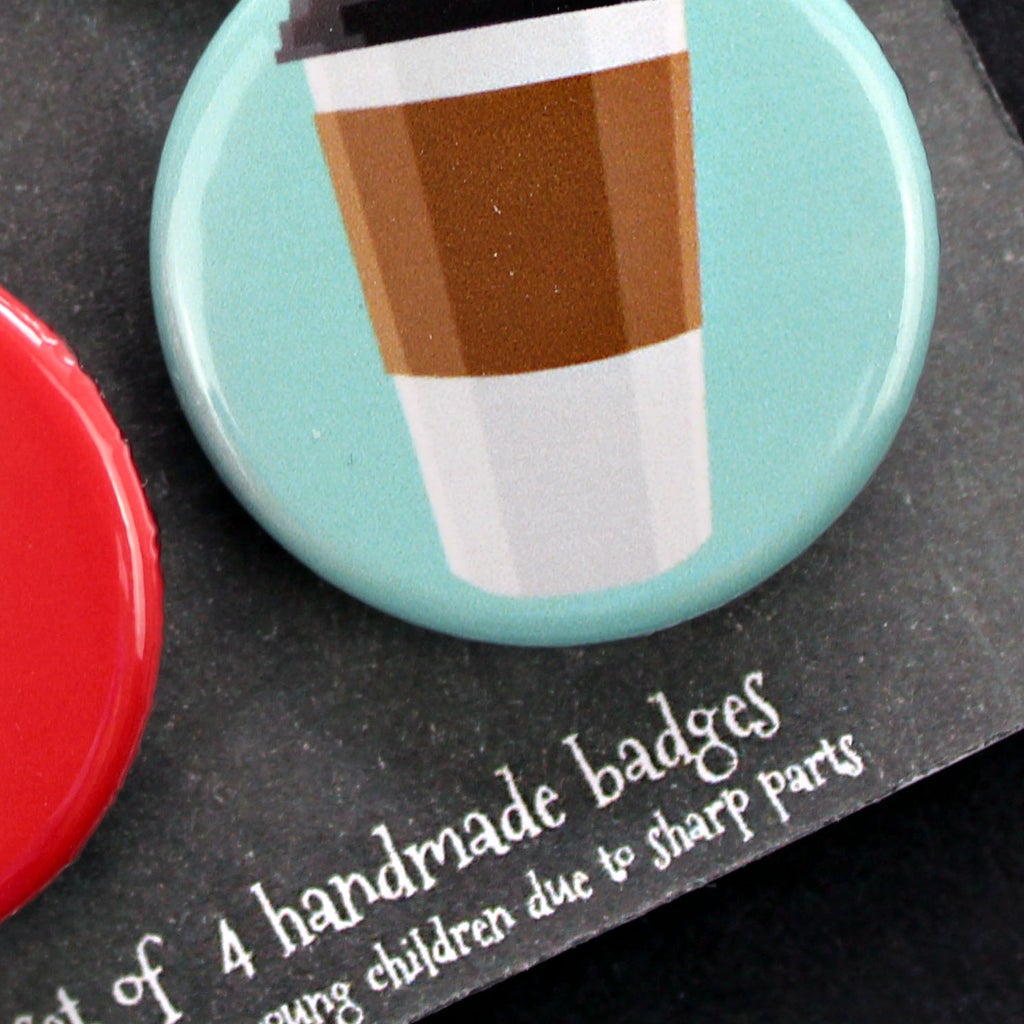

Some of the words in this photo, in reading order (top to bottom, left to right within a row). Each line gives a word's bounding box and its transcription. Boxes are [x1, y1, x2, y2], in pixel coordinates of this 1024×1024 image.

[112, 933, 183, 1024] of
[217, 918, 256, 979] 4
[250, 765, 566, 957] handmade
[562, 671, 780, 809] badges
[366, 906, 517, 991] children
[526, 870, 593, 920] due
[598, 845, 635, 883] to
[647, 788, 753, 870] sharp
[757, 734, 864, 822] parts
